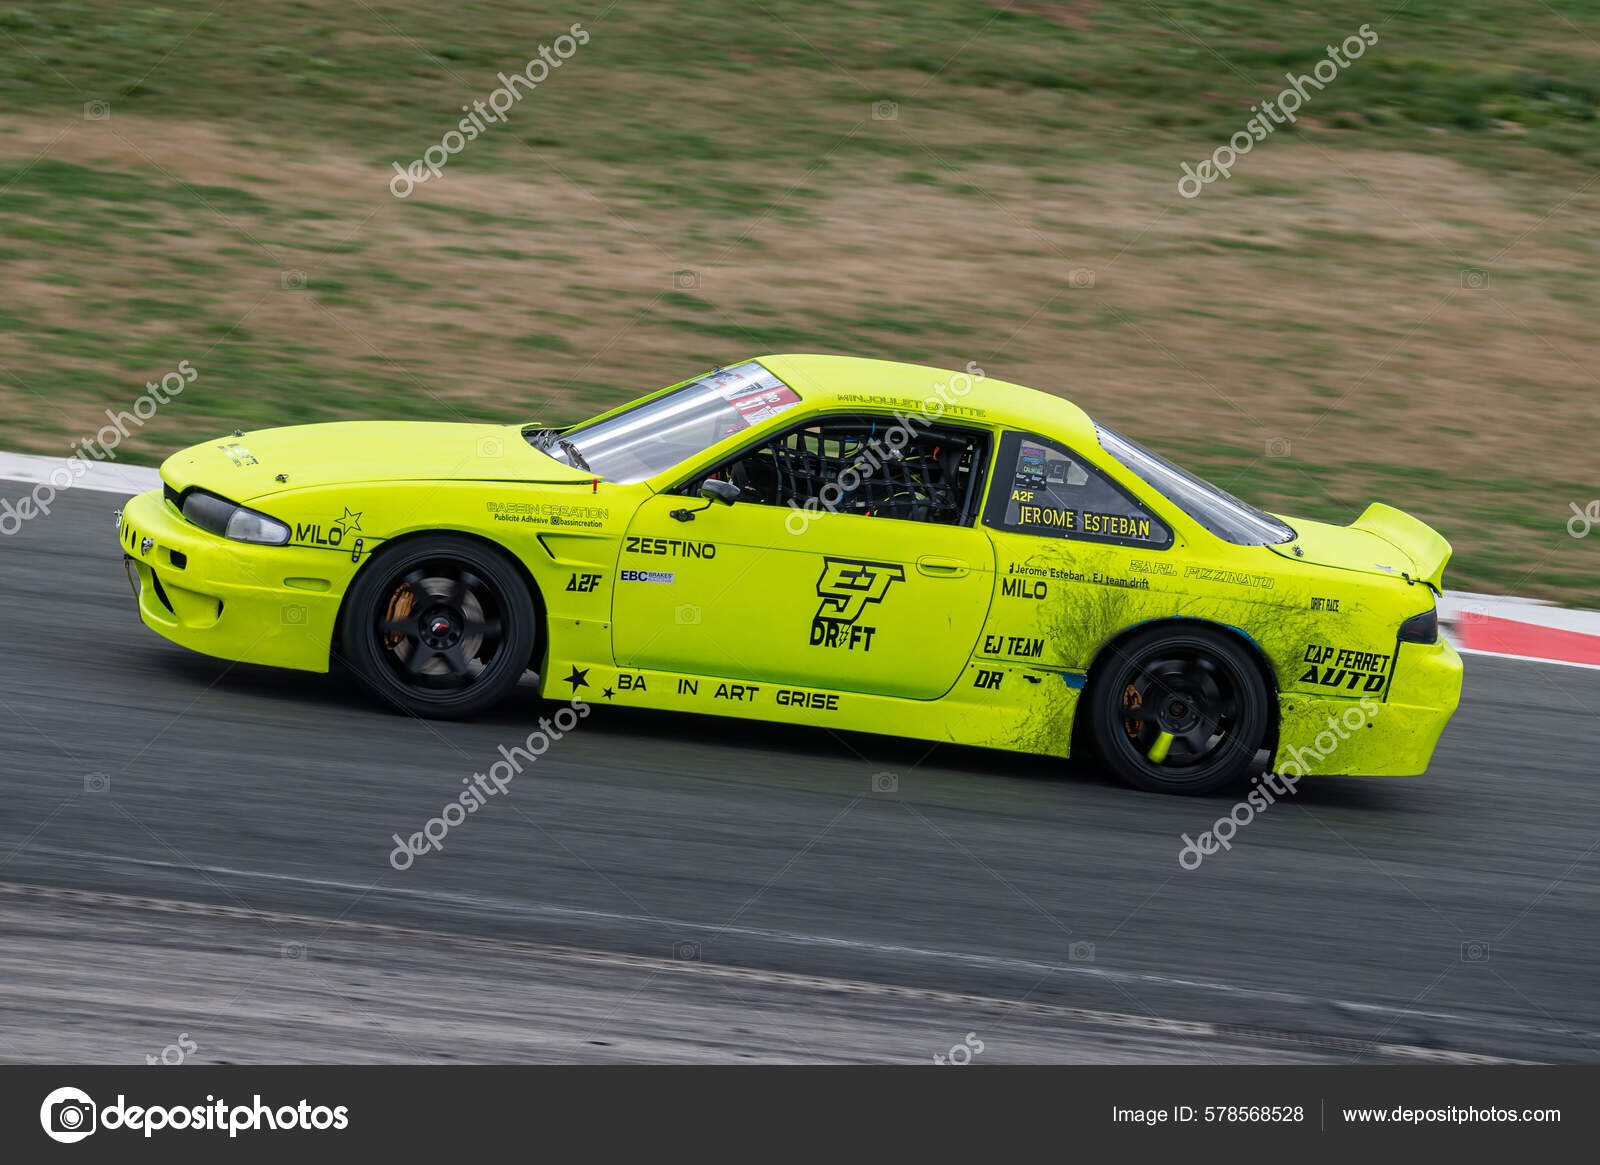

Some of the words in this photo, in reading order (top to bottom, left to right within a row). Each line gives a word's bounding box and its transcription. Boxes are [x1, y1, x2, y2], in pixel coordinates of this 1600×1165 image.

[1011, 490, 1034, 502] A2F
[487, 502, 539, 515] BASSIN
[541, 504, 609, 519] CREATION
[1018, 506, 1074, 528] JEROME
[1084, 514, 1150, 536] ESTEBAN
[296, 523, 342, 546] MILO
[626, 536, 716, 559] ZESTINO
[566, 573, 602, 592] A2F
[620, 570, 648, 582] EBC
[1015, 564, 1048, 576] Jerome
[1050, 567, 1085, 581] Esteban
[1092, 573, 1104, 583] EJ
[1002, 577, 1048, 600] MILO
[1311, 597, 1326, 610] DRIFT
[1326, 598, 1339, 612] RACE
[984, 635, 1004, 654] EJ
[1008, 637, 1044, 657] TEAM
[1304, 644, 1334, 664] CAP
[1335, 649, 1390, 673] FERRET
[973, 670, 1004, 690] DR
[1298, 665, 1386, 692] AUTO
[618, 674, 647, 691] BA
[678, 679, 698, 696] IN
[714, 684, 759, 702] ART
[776, 690, 840, 711] GRISE
